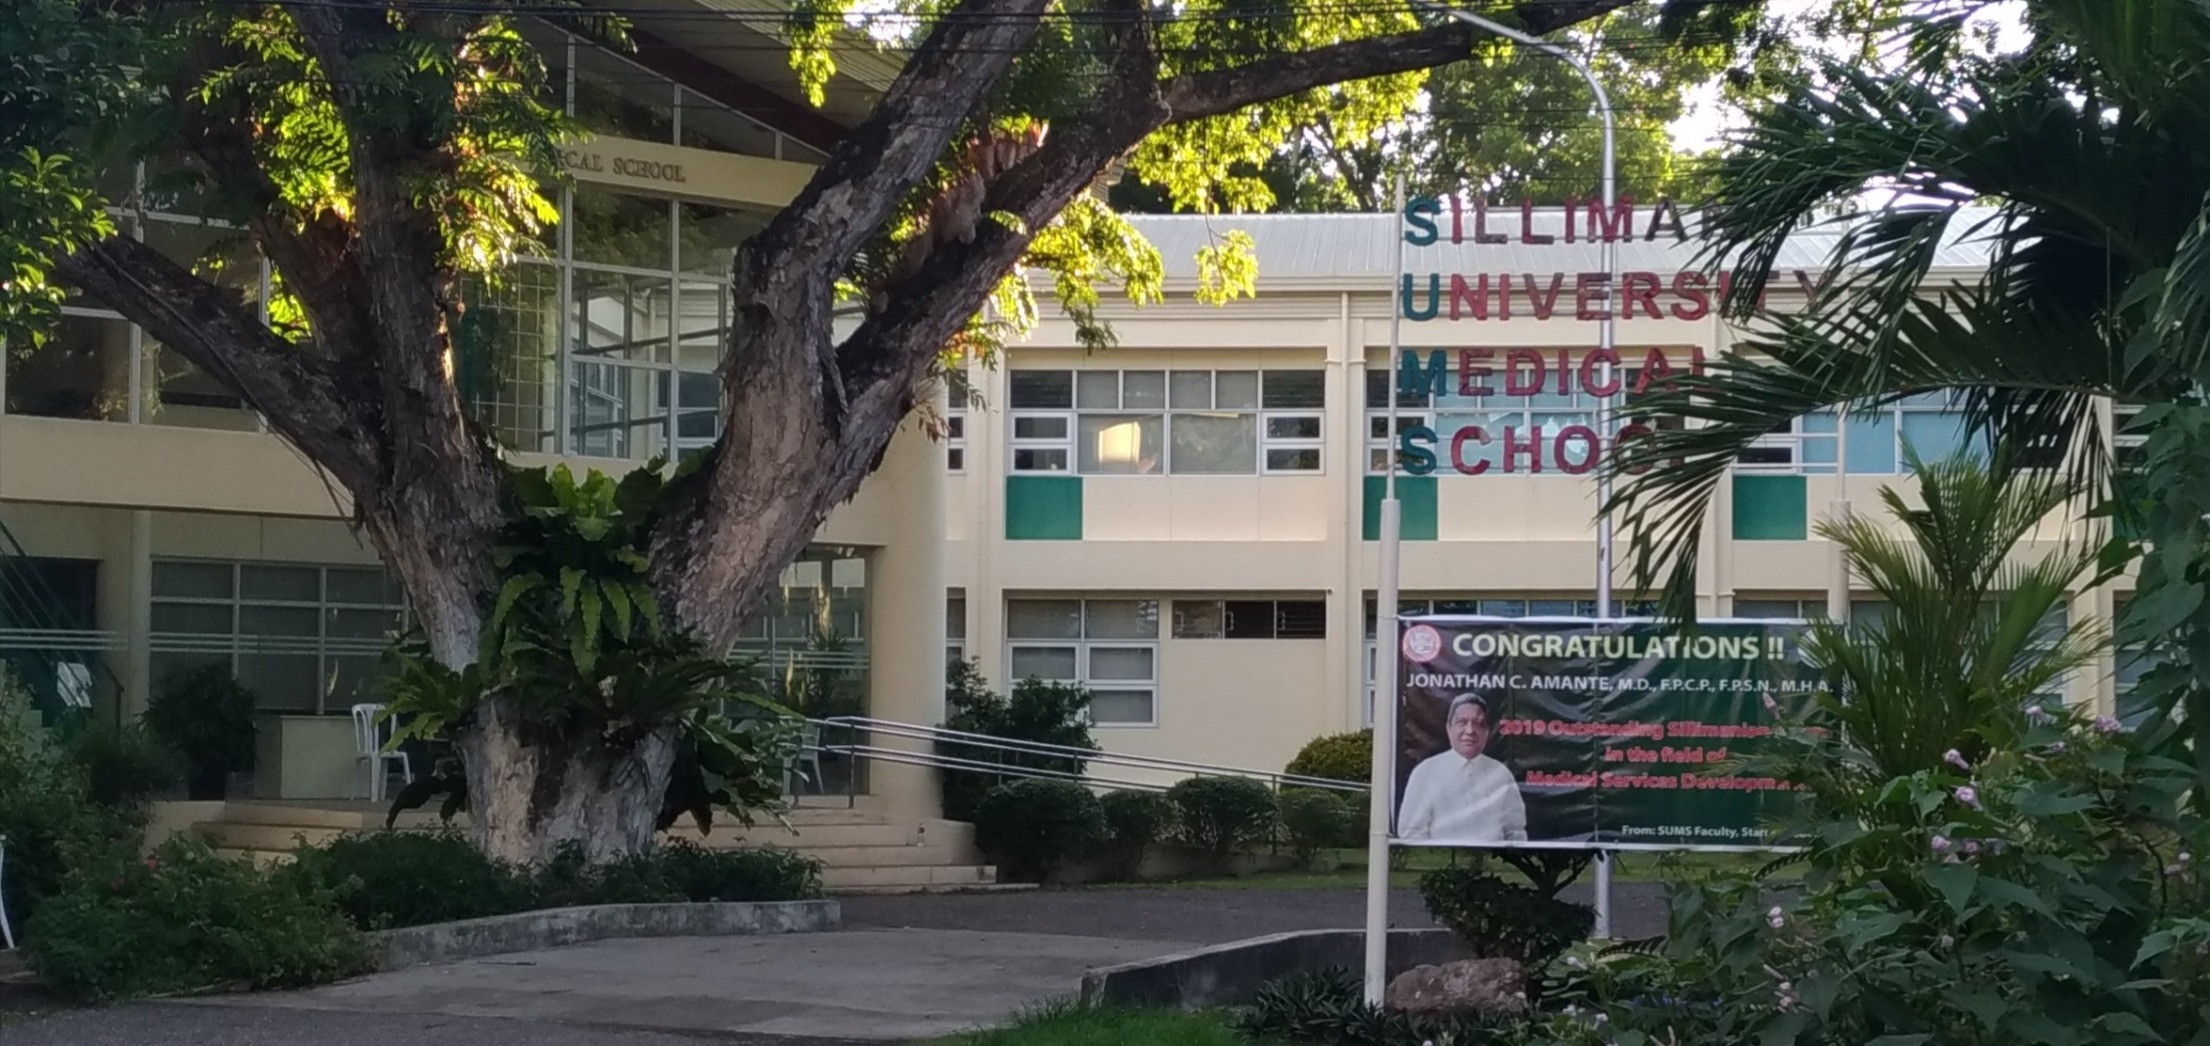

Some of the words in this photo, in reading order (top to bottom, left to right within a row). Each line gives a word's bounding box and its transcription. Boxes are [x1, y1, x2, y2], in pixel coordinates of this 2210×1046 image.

[613, 157, 687, 183] SCHOOL
[1452, 632, 1760, 661] CONGRATULATIONS
[1767, 636, 1785, 660] !!
[1406, 672, 1506, 690] JONATHAN
[1509, 674, 1527, 690] C.
[1530, 674, 1614, 692] AMANTE,
[1617, 678, 1658, 693] M.D.,
[1781, 680, 1835, 694] M.H.A.
[1499, 718, 1546, 736] 2019
[1548, 719, 1664, 741] Outstanding
[1666, 720, 1771, 738] Sillimanian
[1604, 745, 1624, 763] in
[1626, 745, 1659, 763] the
[1660, 746, 1704, 764] field
[1706, 746, 1727, 763] of
[1525, 770, 1598, 788] Medical
[1600, 771, 1678, 789] Services
[1621, 824, 1656, 836] From:
[1657, 825, 1692, 837] SUMS
[1694, 825, 1739, 839] Faculty,
